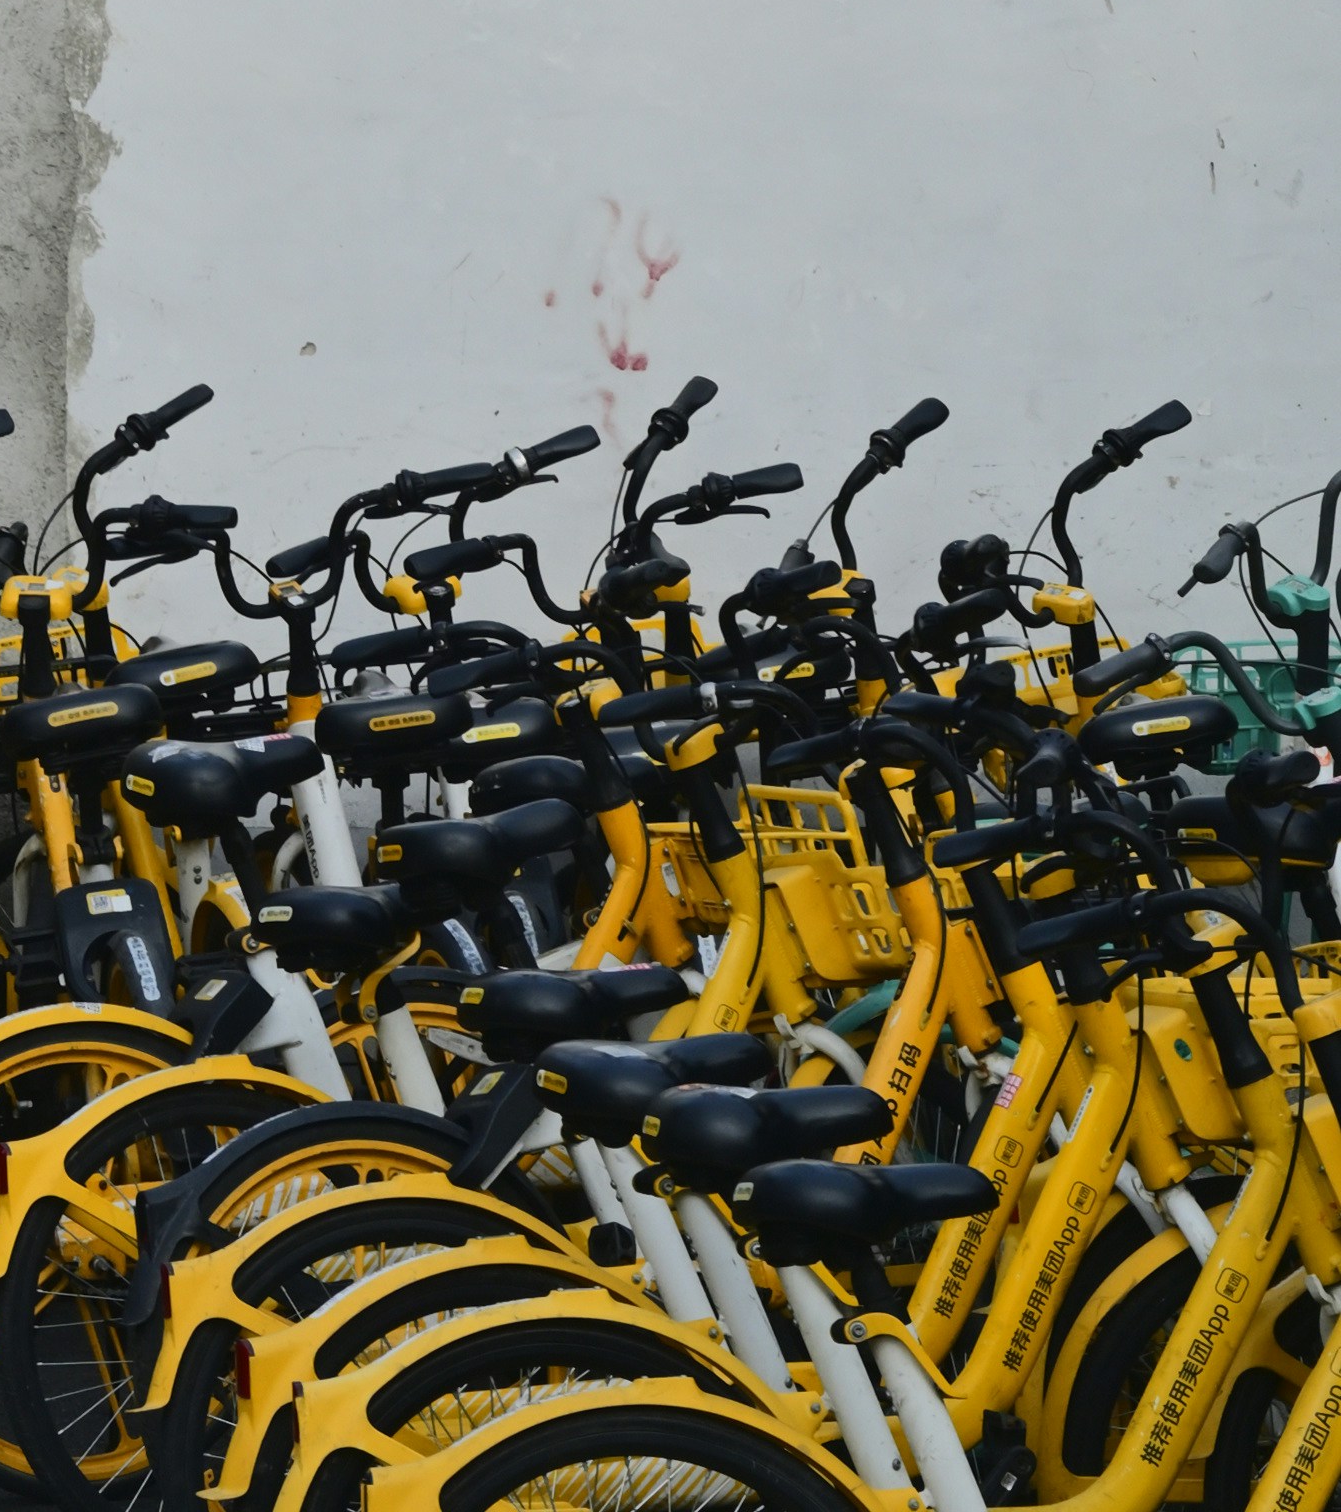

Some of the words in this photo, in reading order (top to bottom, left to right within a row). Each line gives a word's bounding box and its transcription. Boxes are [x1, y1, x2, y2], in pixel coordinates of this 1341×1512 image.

[1002, 1216, 1082, 1373] 推荐使用美团App
[1140, 1304, 1231, 1467] 推荐使用美团App
[1273, 1384, 1341, 1512] 使用美团App
